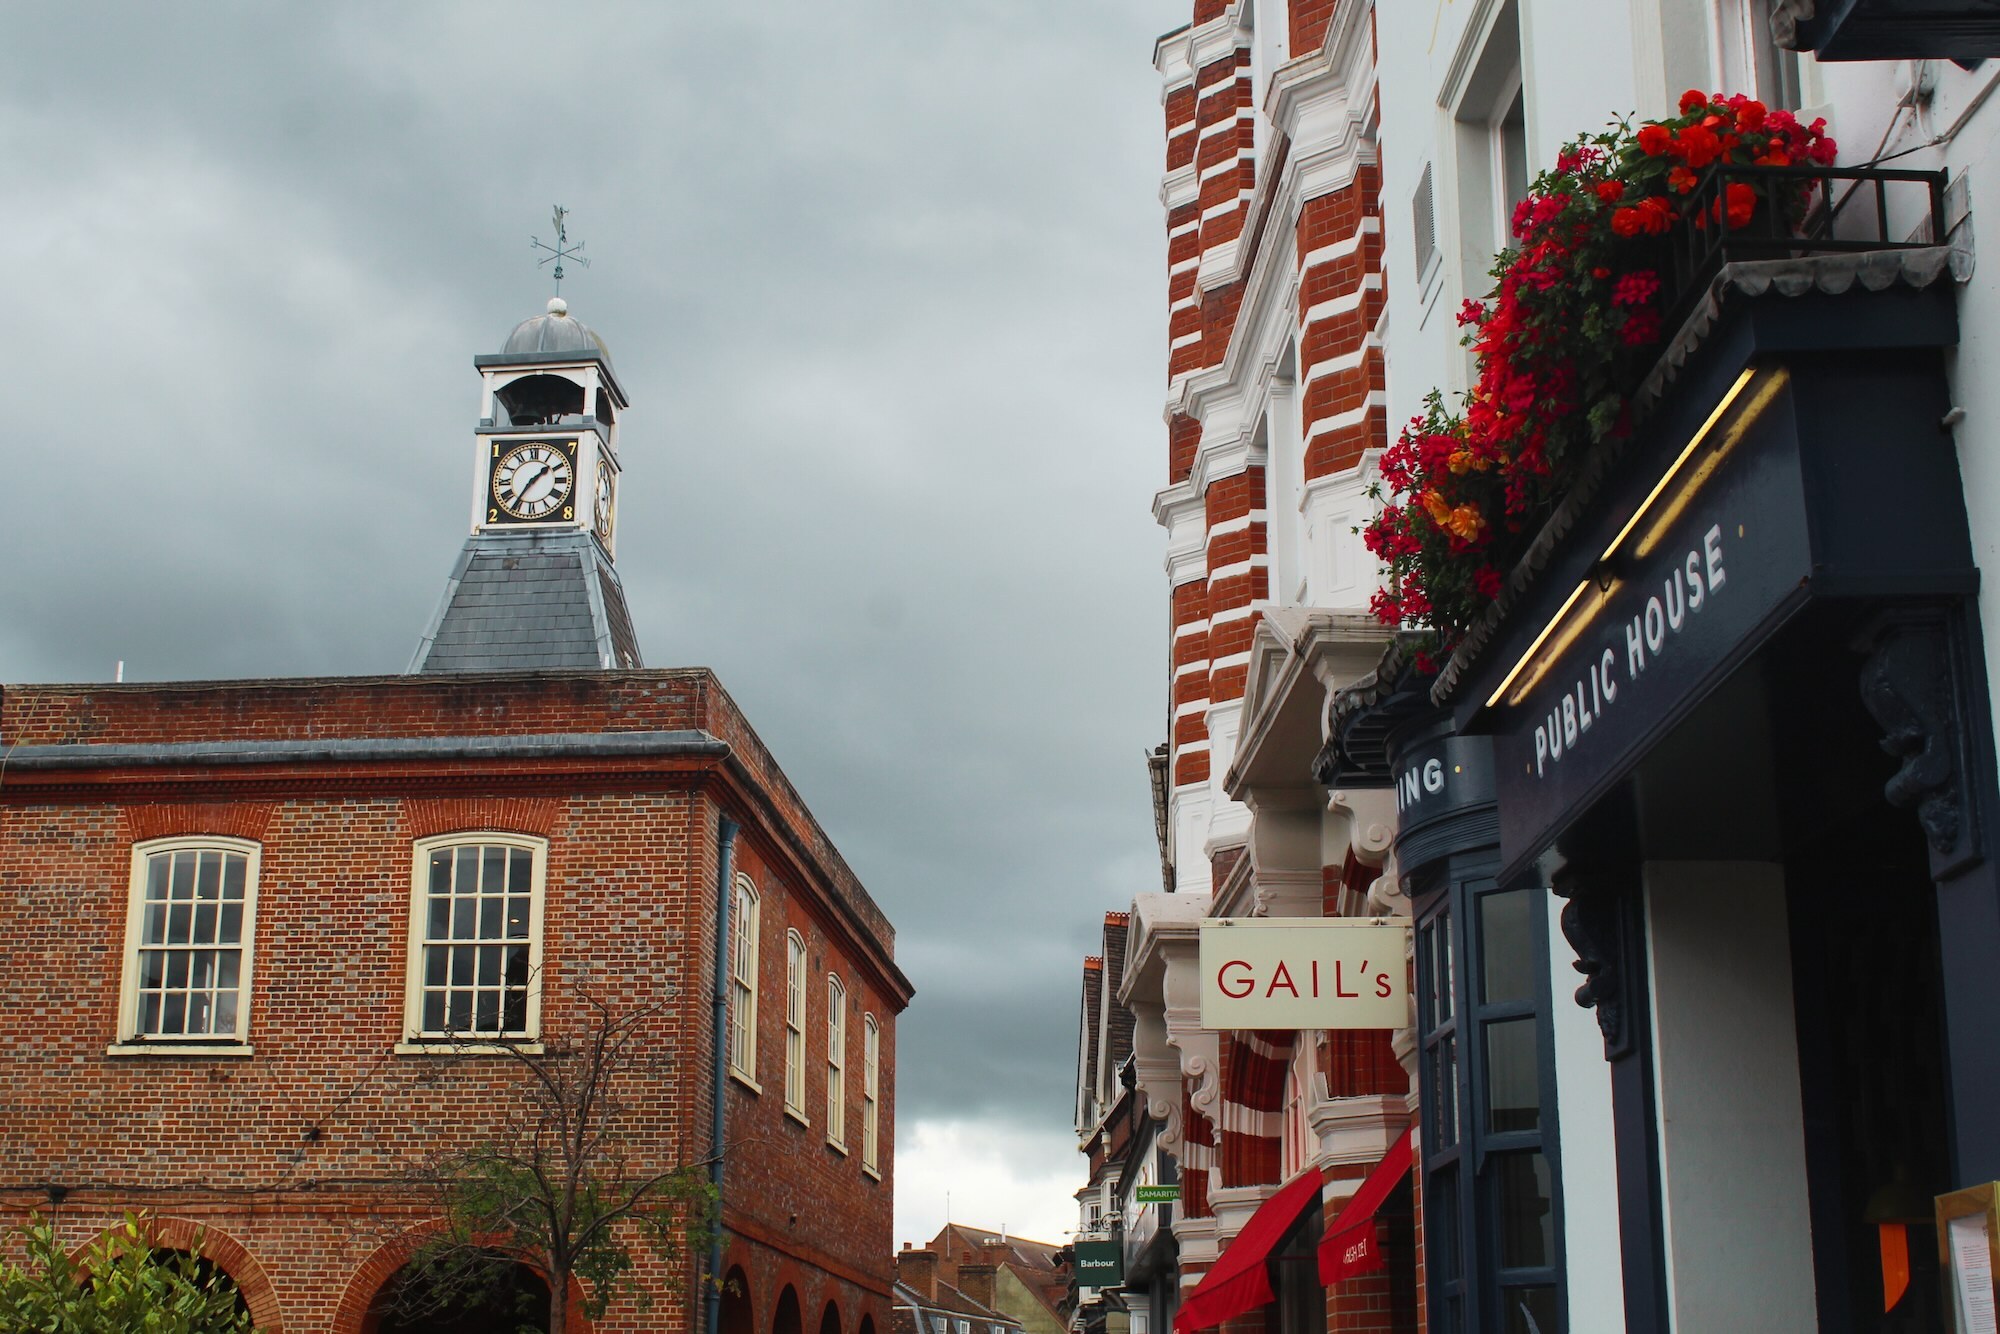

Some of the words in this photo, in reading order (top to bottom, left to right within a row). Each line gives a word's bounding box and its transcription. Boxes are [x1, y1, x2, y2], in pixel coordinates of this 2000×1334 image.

[493, 444, 500, 458] 1
[568, 442, 577, 455] 7
[489, 509, 498, 522] 2
[563, 506, 573, 520] 8
[1535, 648, 1618, 778] PUBLIC
[1626, 524, 1727, 680] HOUSE
[1395, 758, 1445, 816] ING
[1217, 960, 1392, 999] GAIL's
[1080, 1259, 1115, 1268] Barbour
